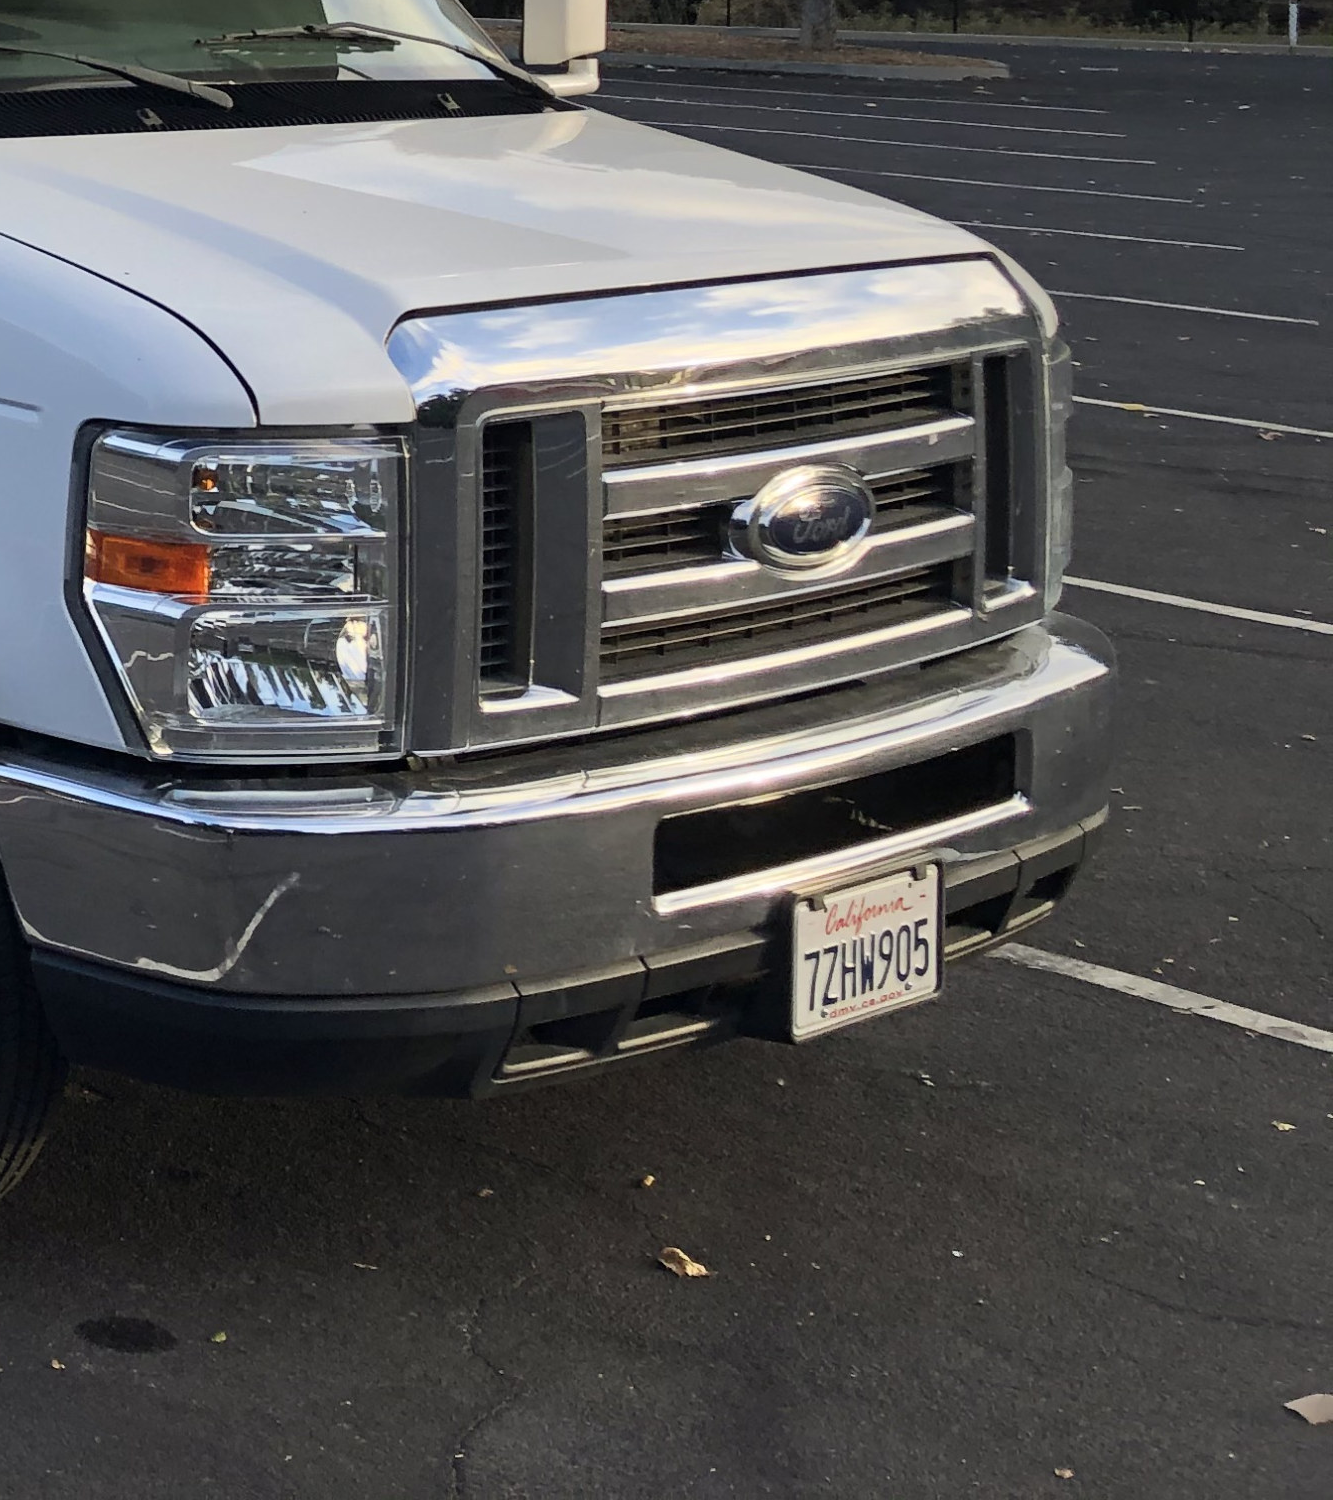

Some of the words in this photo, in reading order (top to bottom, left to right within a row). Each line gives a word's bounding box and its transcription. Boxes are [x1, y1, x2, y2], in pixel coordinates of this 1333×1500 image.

[791, 505, 852, 544] Ford
[825, 896, 914, 936] California
[804, 917, 930, 1012] 7ZHW905
